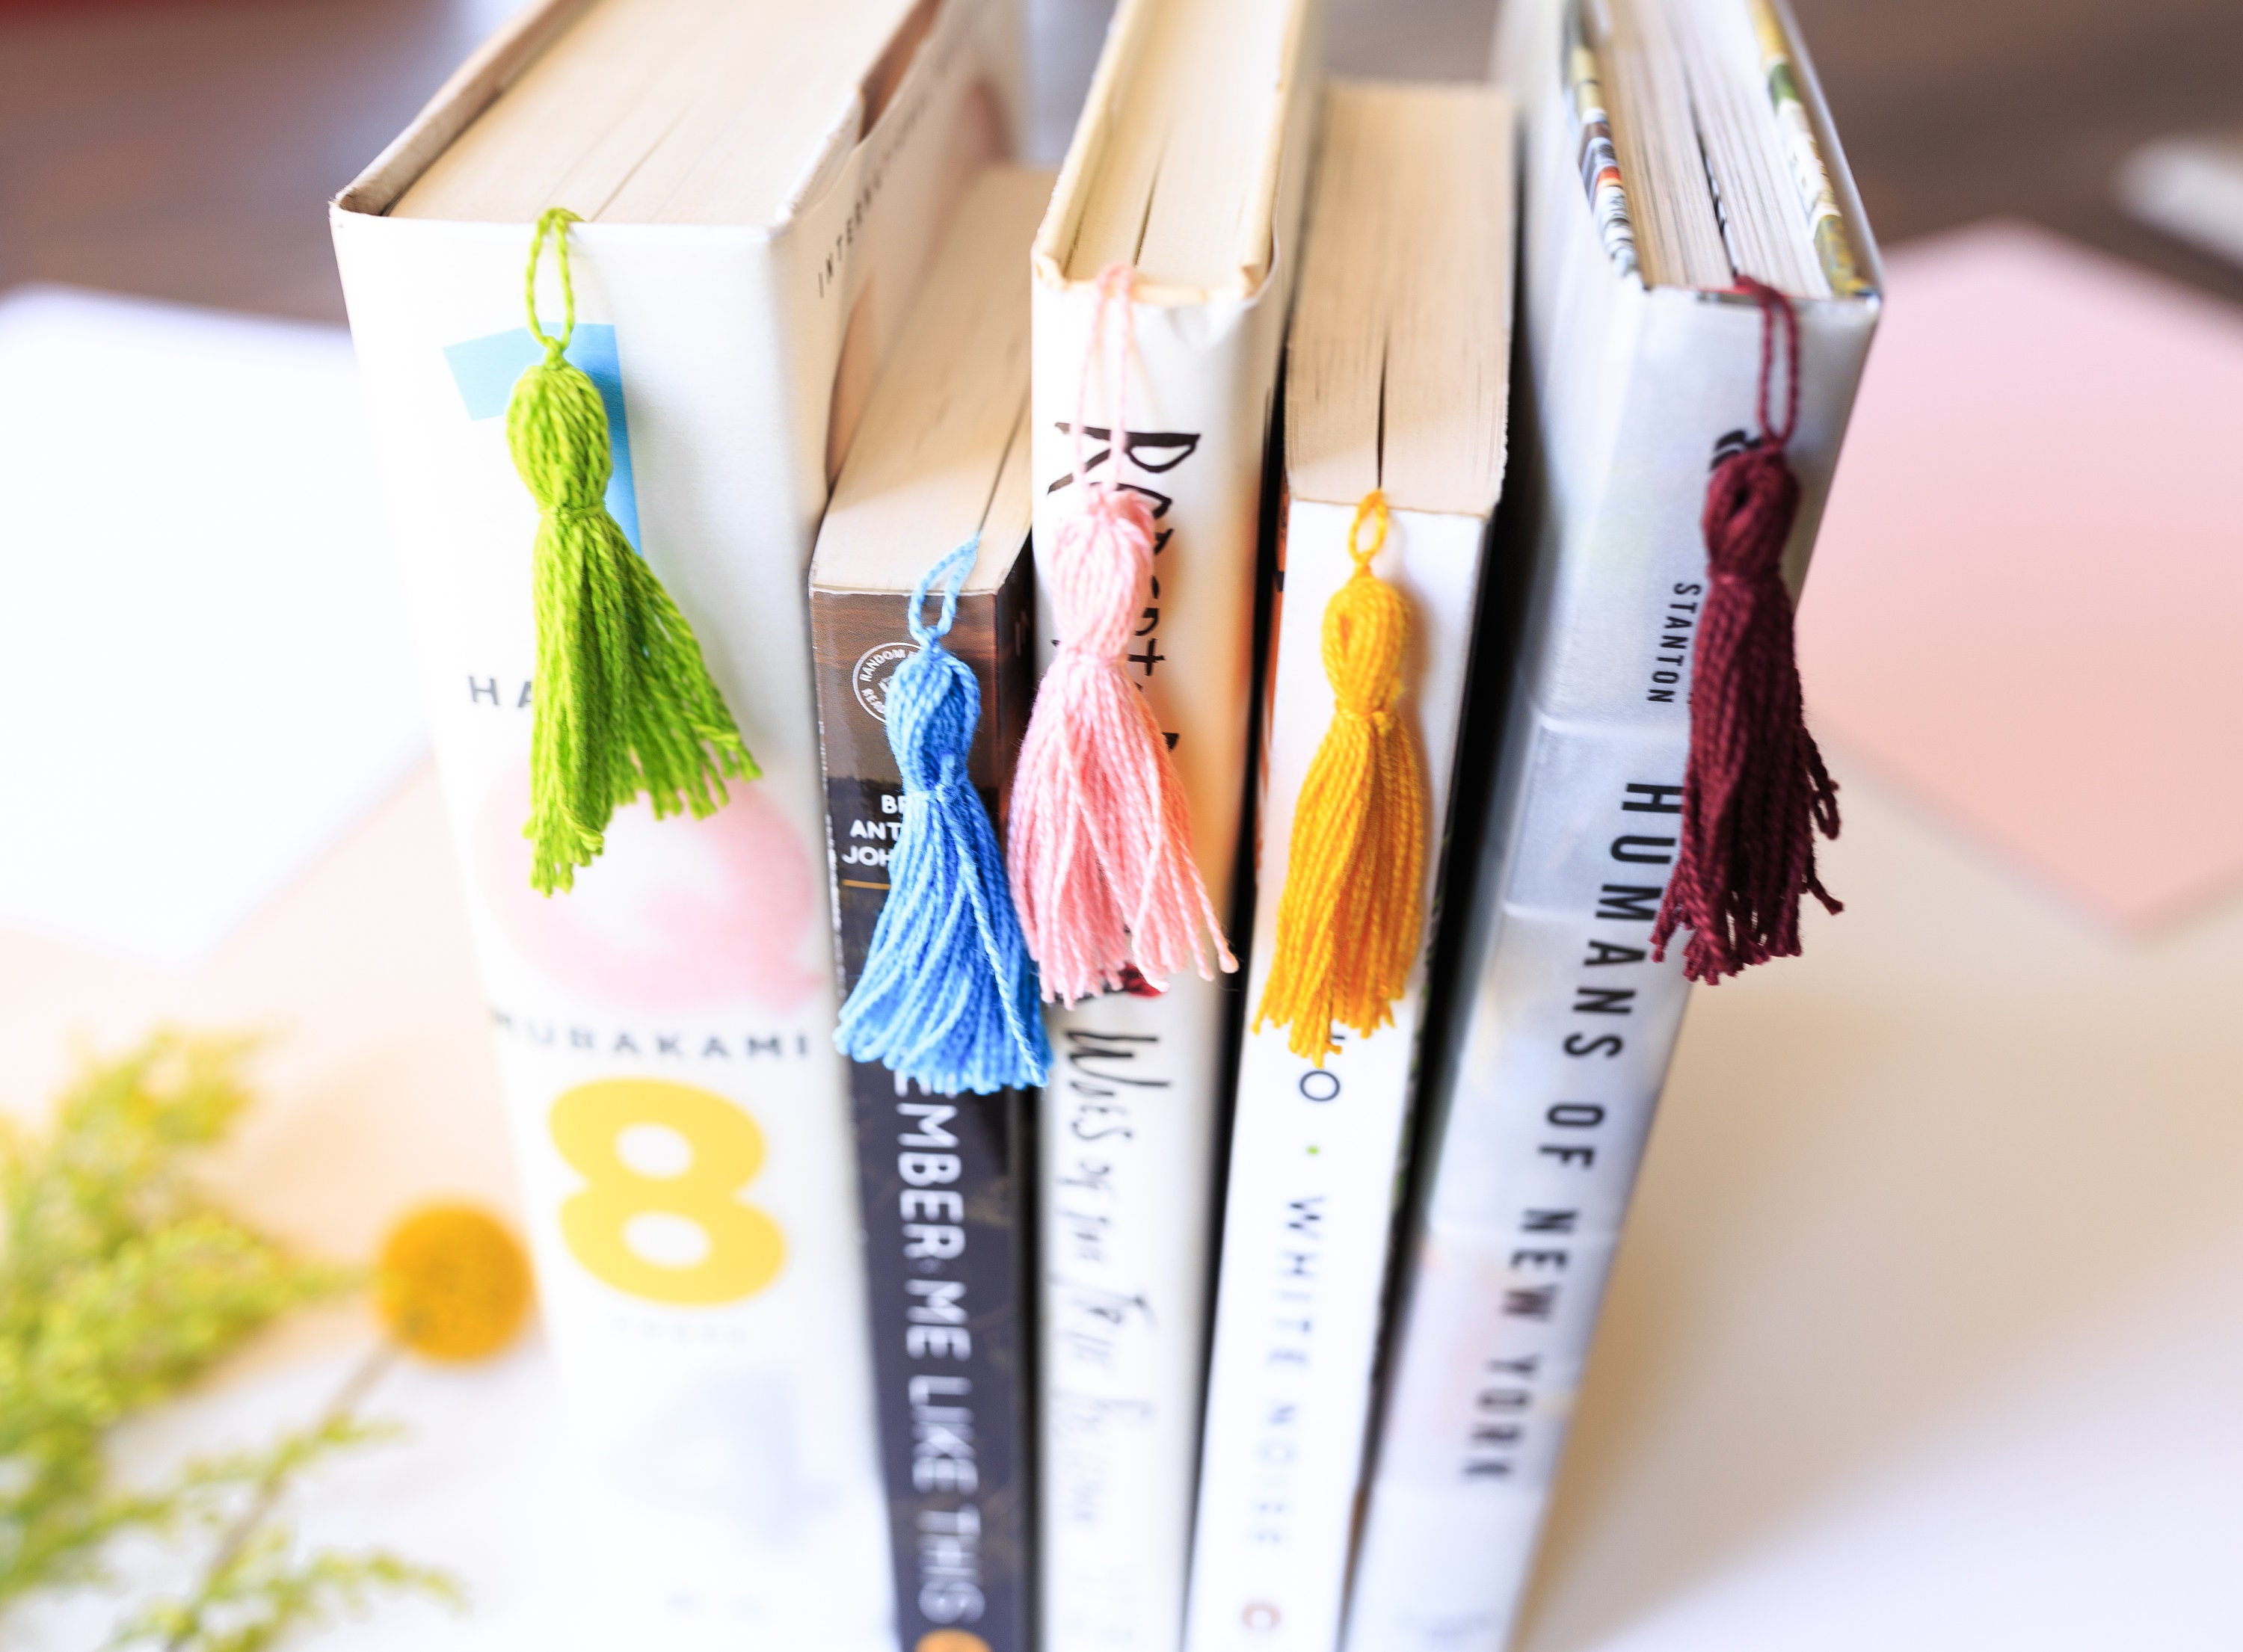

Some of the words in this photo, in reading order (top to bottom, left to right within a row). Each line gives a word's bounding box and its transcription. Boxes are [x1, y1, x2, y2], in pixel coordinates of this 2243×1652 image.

[859, 648, 906, 682] RANDOM
[1646, 581, 1702, 704] STANTON
[1563, 782, 1683, 1061] HUMANS
[486, 1009, 810, 1058] MURAKAMI
[547, 1075, 788, 1309] 8
[893, 1067, 967, 1261] EMBER
[1537, 1101, 1607, 1170] OF
[903, 1277, 973, 1361] ME
[1264, 1195, 1326, 1370] WHITE
[1498, 1207, 1580, 1322] NEW
[908, 1374, 980, 1495] LIKE
[1460, 1354, 1542, 1485] YORK
[916, 1502, 988, 1624] THIS
